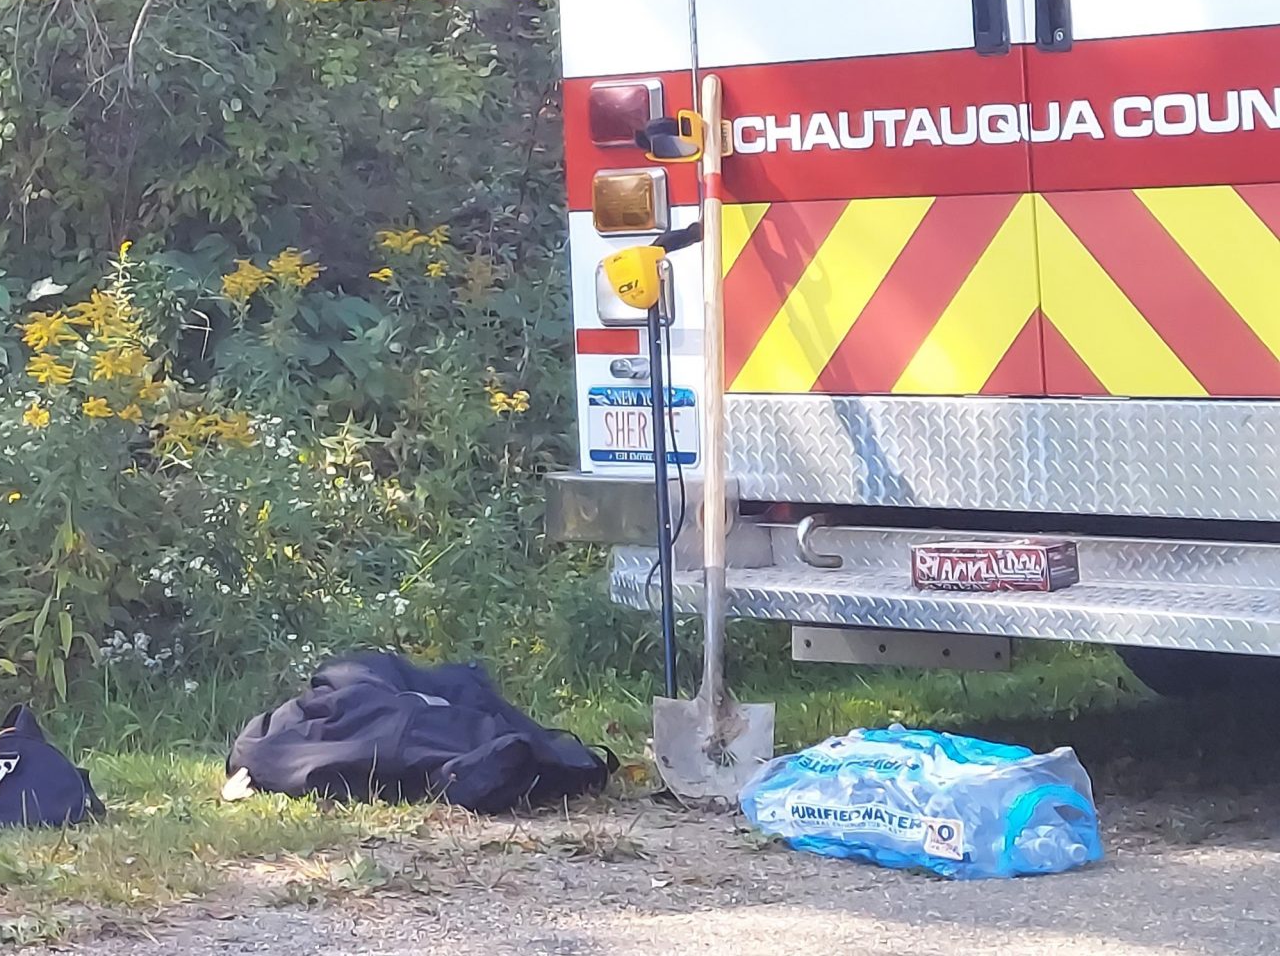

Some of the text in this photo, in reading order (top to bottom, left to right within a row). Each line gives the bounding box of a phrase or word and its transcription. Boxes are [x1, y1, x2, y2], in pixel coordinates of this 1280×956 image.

[732, 99, 1105, 155] CHAUTAUQUA
[1113, 87, 1280, 138] COUN
[613, 390, 637, 405] NEW
